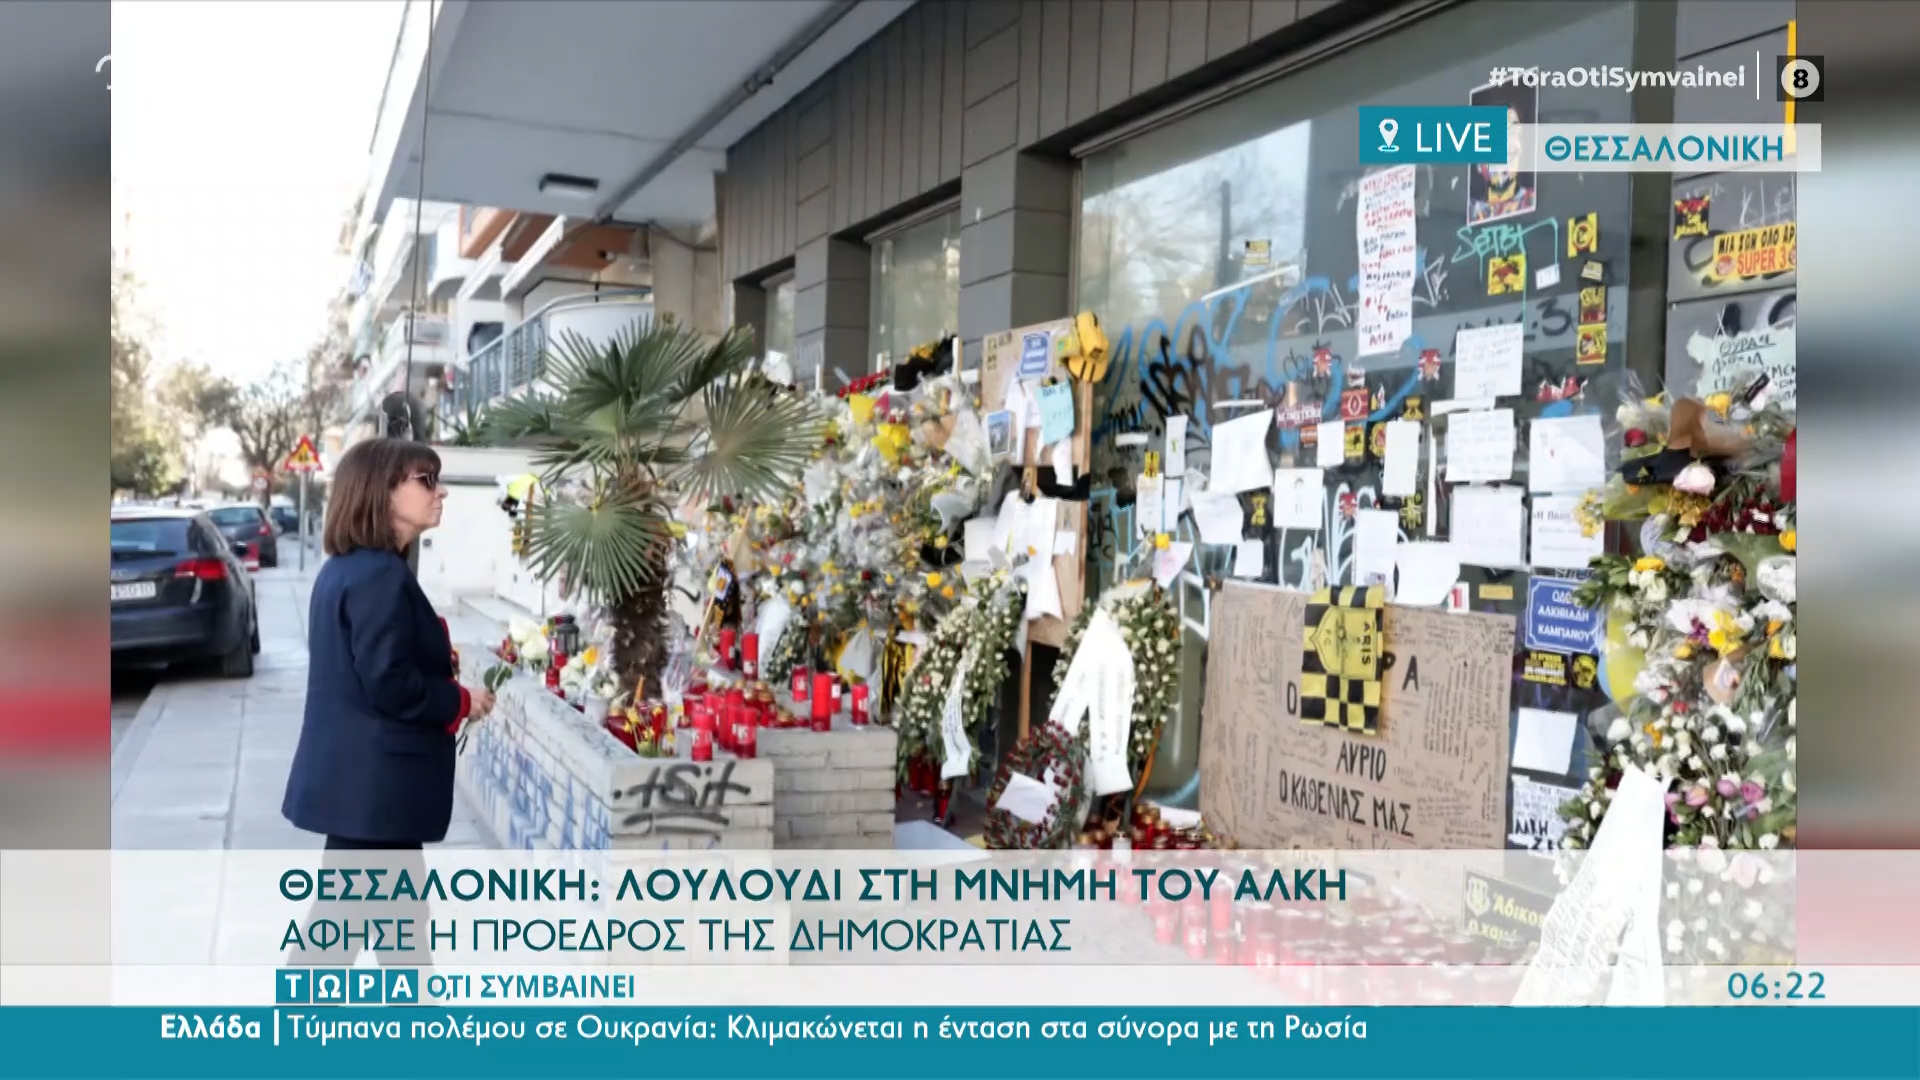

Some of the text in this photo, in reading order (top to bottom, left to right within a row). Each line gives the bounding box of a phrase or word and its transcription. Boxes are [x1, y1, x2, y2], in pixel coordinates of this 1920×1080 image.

[1737, 245, 1787, 275] SUPER 3
[1552, 589, 1577, 604] ΟΔΟ
[1362, 620, 1371, 665] ARIS
[1538, 623, 1591, 642] ΚΑΜΠΑΝΟΥ
[1336, 740, 1387, 782] ΑΥΡΙΟ
[1291, 773, 1366, 825] ΚΑΘΕΝΑΣ
[1373, 796, 1415, 838] ΜΑΣ
